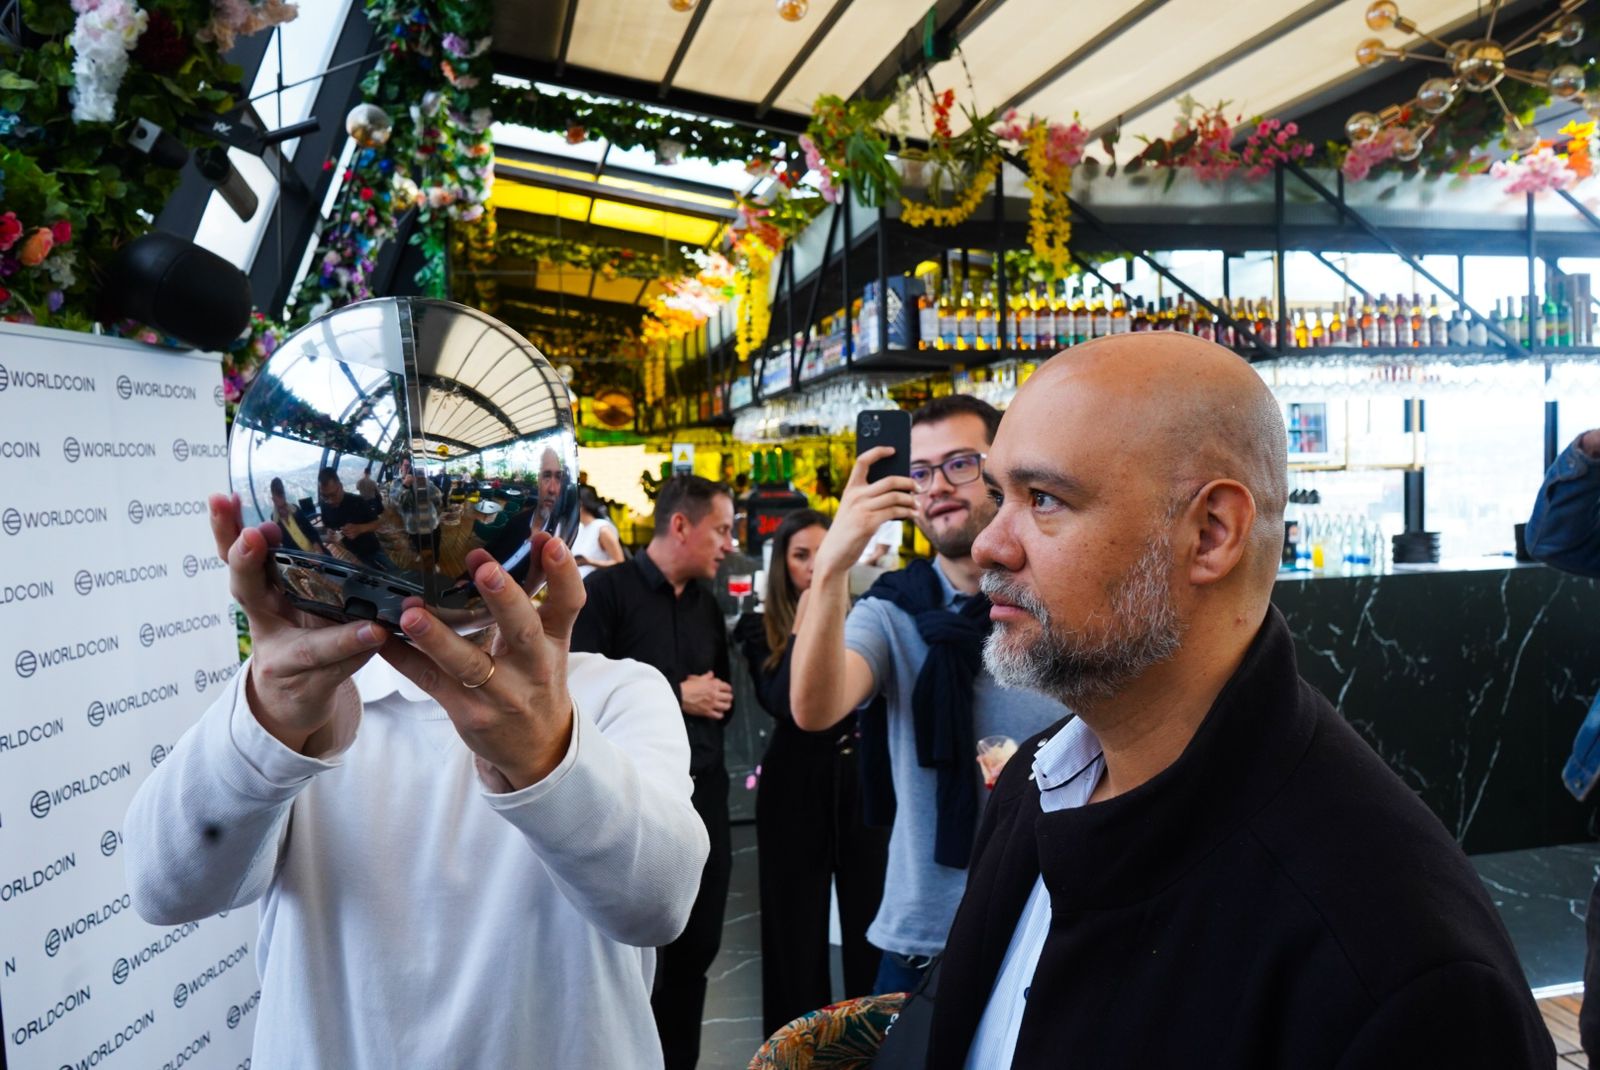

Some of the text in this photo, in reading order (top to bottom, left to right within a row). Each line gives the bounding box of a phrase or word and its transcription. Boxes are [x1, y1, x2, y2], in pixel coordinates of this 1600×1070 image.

[10, 371, 95, 392] WORLDCOIN
[133, 381, 196, 399] WORLDCOIN
[82, 443, 156, 457] WORLDCOIN
[24, 507, 107, 528] WORLDCOIN
[94, 564, 167, 587] WORLDCOIN
[155, 613, 221, 639] WORLDCOIN
[39, 636, 119, 668] WORLDCOIN
[106, 683, 179, 717] WORLDCOIN
[51, 761, 131, 806] WORLDCOIN
[0, 852, 75, 902] ORLDCOIN
[61, 893, 131, 942] WORLDCO
[188, 942, 248, 995] WORLDCOIN
[12, 985, 91, 1045] ORLDCOIN
[75, 1009, 154, 1070] WORLDCOIN
